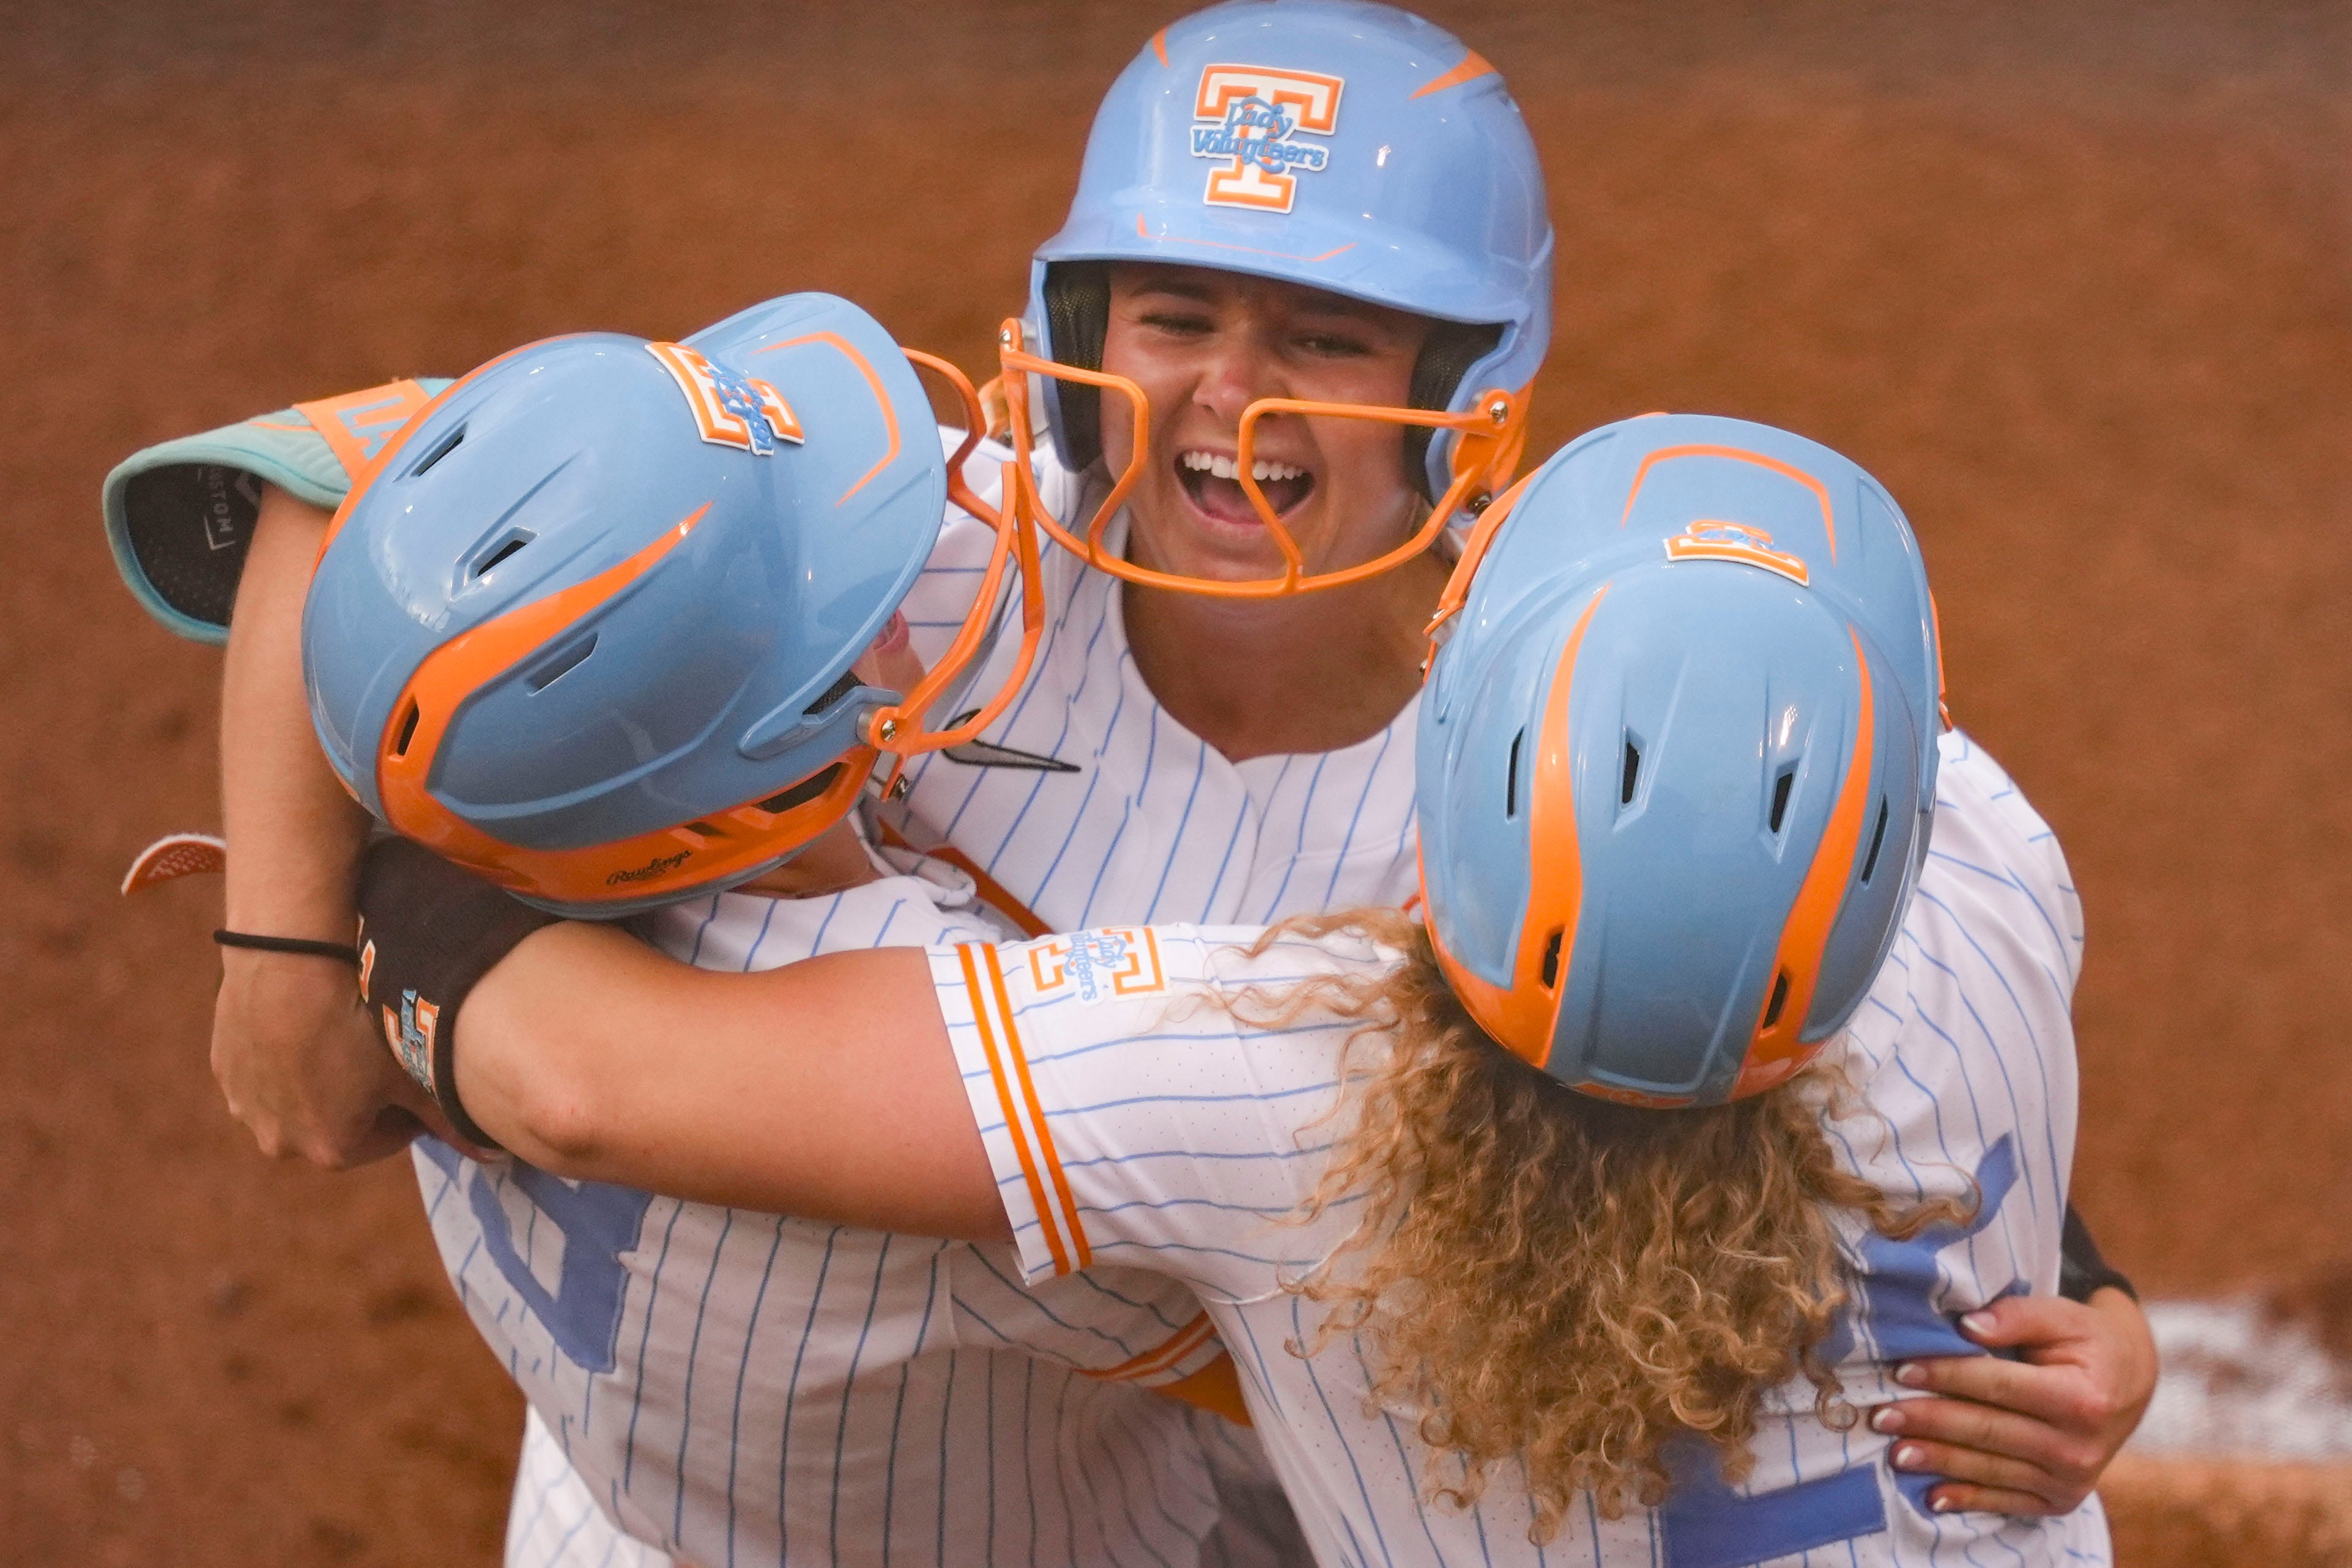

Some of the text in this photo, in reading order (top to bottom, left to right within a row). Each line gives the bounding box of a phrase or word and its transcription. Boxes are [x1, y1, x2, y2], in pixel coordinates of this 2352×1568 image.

[1195, 64, 1344, 212] T
[1225, 95, 1293, 138] Lady
[1193, 128, 1325, 174] Volunteers
[606, 849, 694, 886] Rawlings
